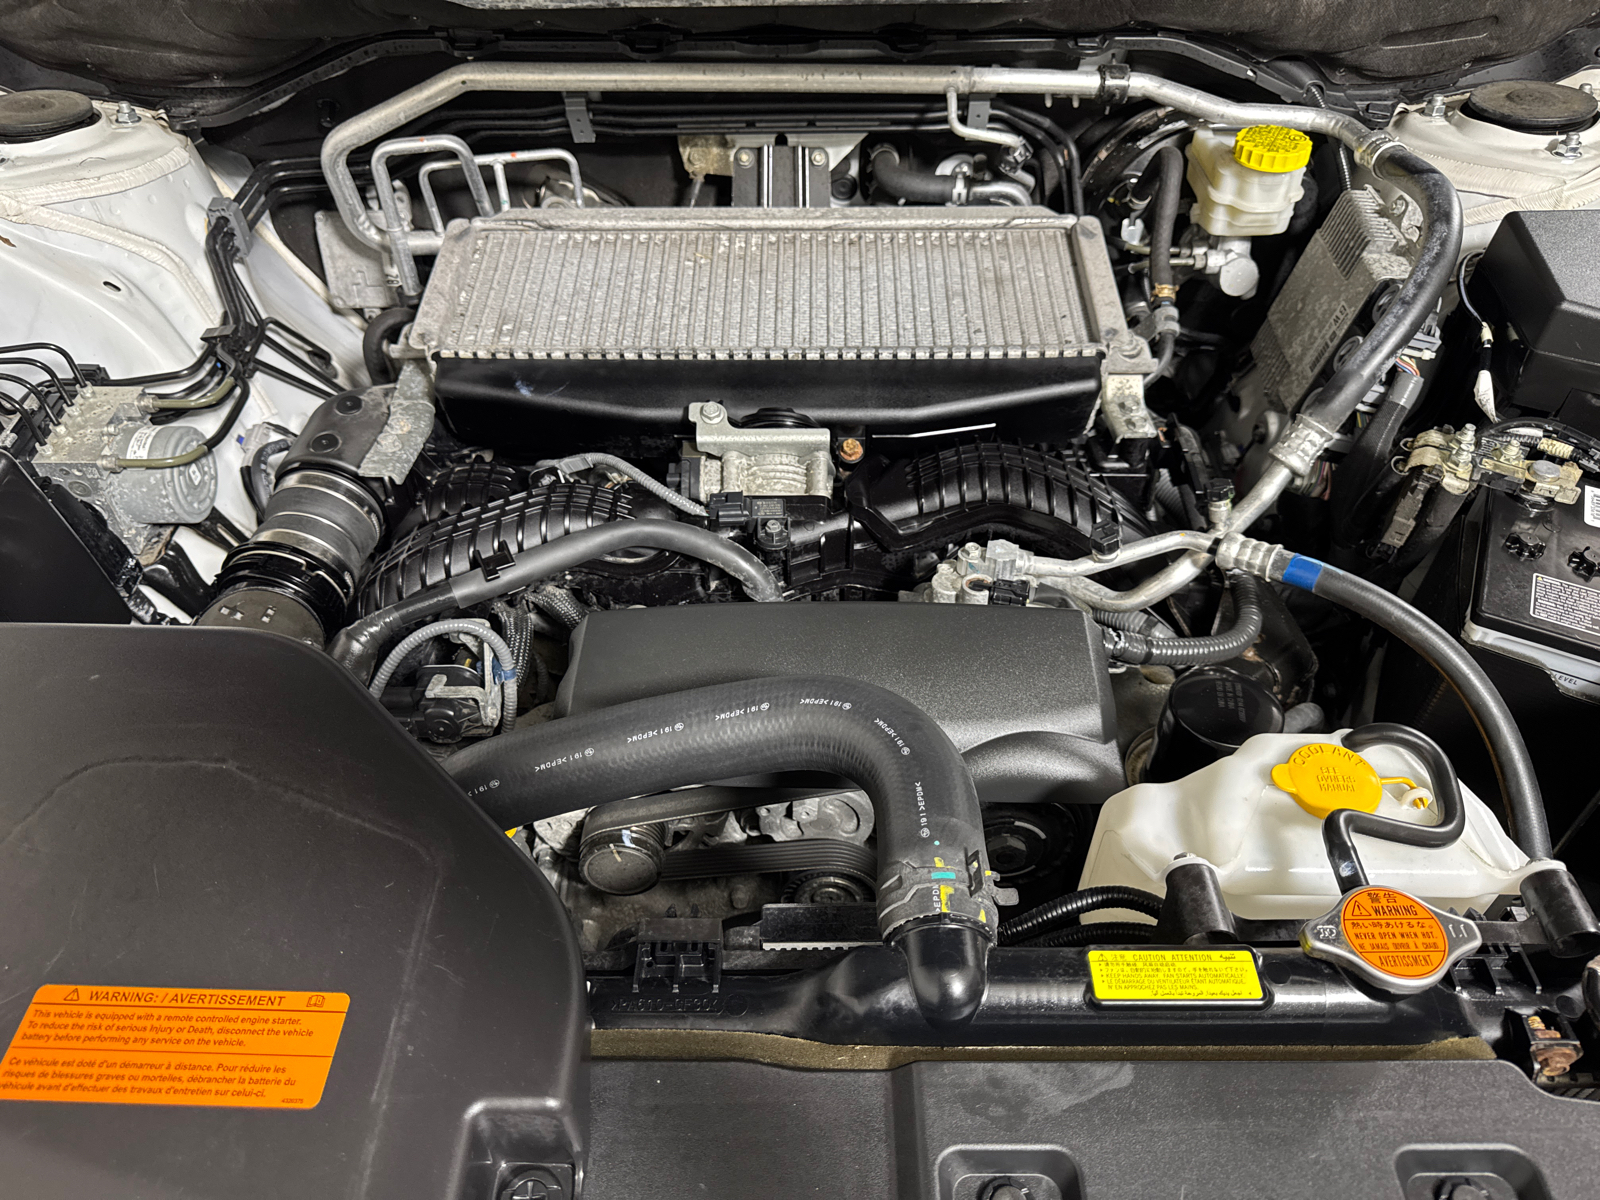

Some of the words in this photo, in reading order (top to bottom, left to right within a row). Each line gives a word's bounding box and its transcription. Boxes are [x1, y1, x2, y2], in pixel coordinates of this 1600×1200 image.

[747, 705, 758, 714] 191
[830, 699, 842, 707] 191
[660, 725, 672, 734] 191
[895, 736, 904, 748] 191
[570, 752, 582, 761] 191
[1293, 745, 1366, 767] COOLANT
[1319, 784, 1356, 792] MANUAL
[920, 812, 928, 826] 191
[1366, 892, 1398, 904] 警告
[1371, 904, 1418, 916] WARNING
[1354, 932, 1376, 940] NEVER
[1378, 932, 1397, 940] OPEN
[1398, 932, 1419, 940] WHEN
[1420, 931, 1438, 939] HOT.
[1358, 942, 1367, 950] NE
[1370, 942, 1390, 950] JAMAIS
[1378, 954, 1434, 968] AVERTISSMENT
[89, 990, 158, 1003] WARNING:
[169, 993, 286, 1007] AVERTISSEMENT
[34, 1009, 50, 1019] This
[54, 1010, 84, 1020] vehicle
[85, 1010, 92, 1020] is
[94, 1011, 134, 1022] equipped
[136, 1012, 154, 1021] with
[156, 1014, 162, 1022] a
[164, 1014, 194, 1022] remote
[196, 1014, 240, 1024] controlled
[240, 1016, 270, 1026] engine
[271, 1016, 302, 1026] starter.
[28, 1020, 38, 1030] To
[40, 1020, 70, 1030] reduce
[71, 1021, 84, 1030] the
[86, 1022, 102, 1031] risk
[105, 1022, 116, 1032] of
[116, 1023, 148, 1032] serious
[176, 1026, 186, 1034] or
[187, 1026, 214, 1036] Death,
[216, 1026, 266, 1036] disconnect
[266, 1028, 280, 1036] the
[283, 1028, 314, 1038] vehicle
[22, 1032, 52, 1043] battery
[53, 1033, 82, 1042] before
[83, 1034, 130, 1045] performing
[132, 1037, 148, 1046] any
[150, 1036, 181, 1045] service
[184, 1038, 196, 1046] on
[197, 1038, 212, 1046] the
[213, 1038, 246, 1047] vehicle.
[9, 1057, 22, 1066] Ce
[24, 1057, 59, 1066] véhicule
[60, 1059, 74, 1068] est
[76, 1058, 96, 1068] doté
[98, 1060, 117, 1068] d'un
[120, 1060, 164, 1070] démarreur
[166, 1061, 172, 1070] à
[174, 1062, 213, 1072] distance.
[216, 1063, 238, 1072] Pour
[239, 1064, 272, 1074] réduire
[274, 1064, 286, 1074] les
[2, 1070, 36, 1080] risques
[39, 1070, 50, 1079] de
[50, 1070, 94, 1080] blessures
[95, 1073, 126, 1082] graves
[142, 1073, 184, 1084] mortelles,
[187, 1075, 237, 1085] débrancher
[238, 1076, 247, 1086] la
[248, 1076, 282, 1086] batterie
[284, 1077, 296, 1086] du
[36, 1083, 61, 1092] avant
[64, 1083, 110, 1092] d'effectuer
[112, 1084, 128, 1094] des
[130, 1085, 162, 1094] travaux
[165, 1086, 212, 1096] d'entretien
[214, 1088, 230, 1096] sur
[232, 1088, 266, 1098] celui-ci.
